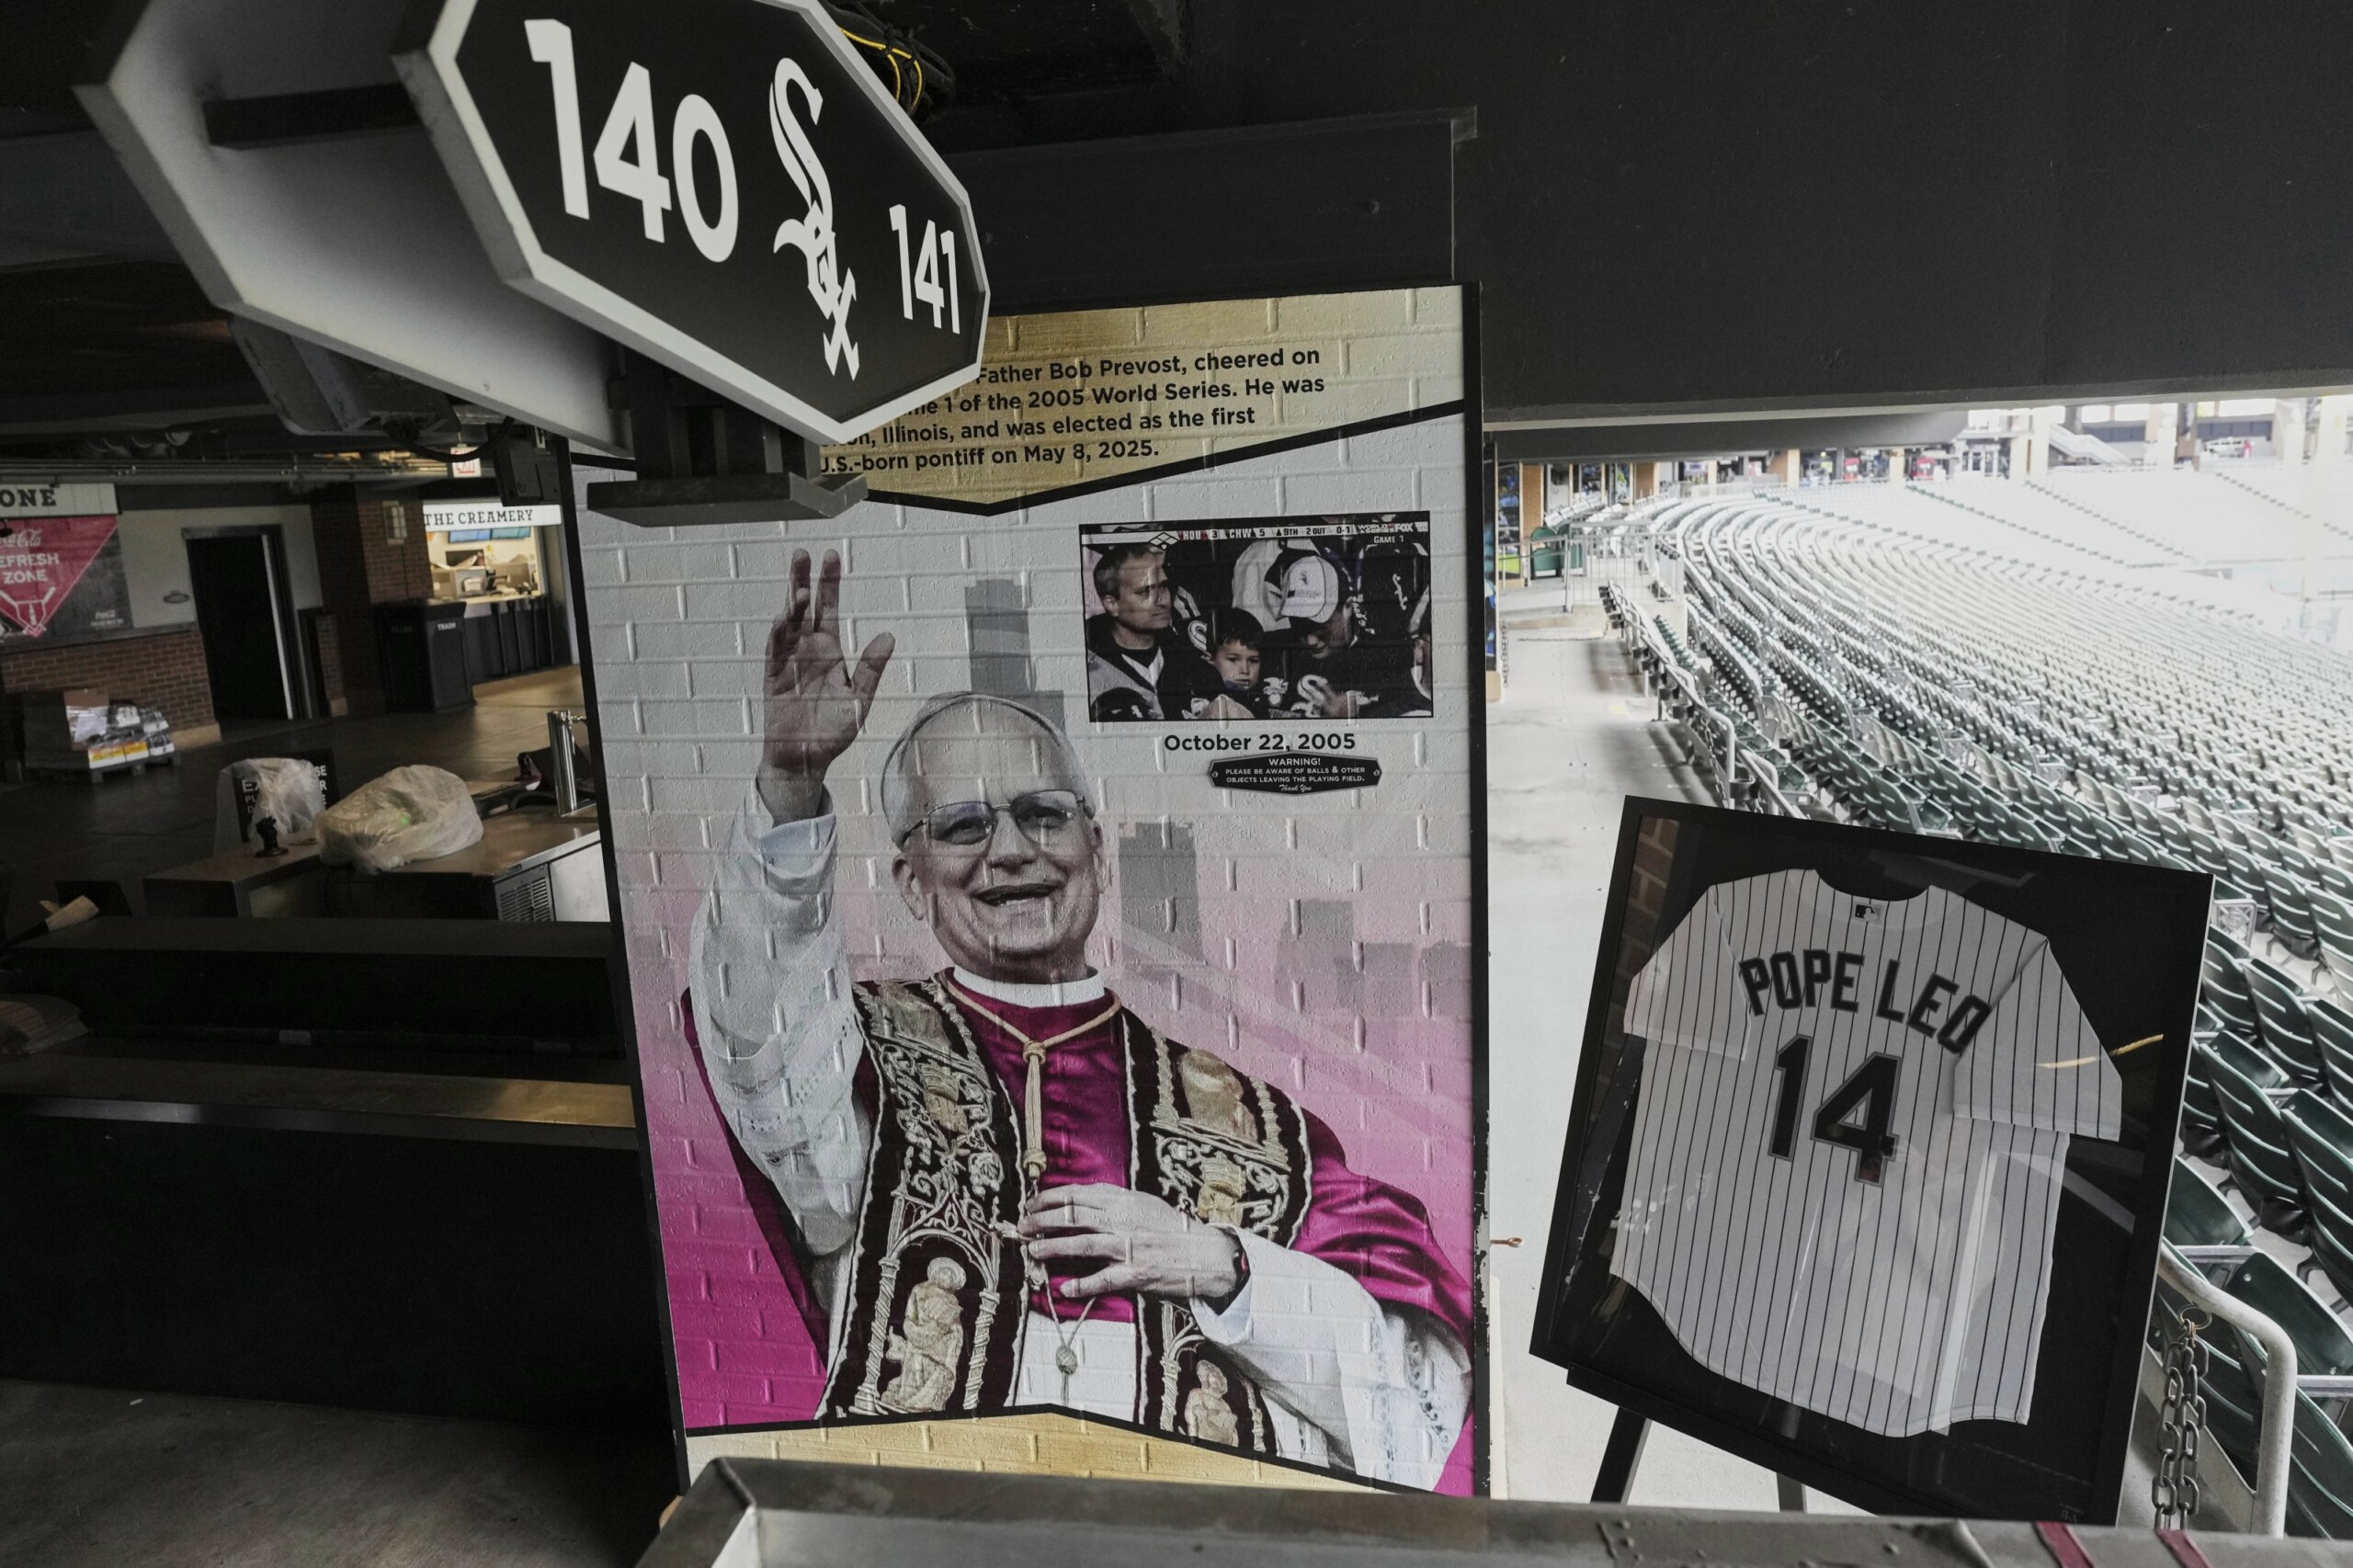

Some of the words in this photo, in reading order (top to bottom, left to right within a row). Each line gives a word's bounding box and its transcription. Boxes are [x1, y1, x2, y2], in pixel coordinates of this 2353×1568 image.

[525, 18, 738, 263] 140
[889, 204, 961, 335] 141
[976, 365, 1042, 384] Father
[1050, 360, 1092, 380] Bob
[1100, 356, 1187, 376] Prevost,
[1194, 348, 1284, 370] cheered
[1291, 350, 1320, 365] on
[945, 397, 953, 413] 1
[960, 394, 982, 412] of
[988, 393, 1021, 410] the
[1029, 389, 1085, 408] 2005
[1092, 384, 1157, 404] World
[1165, 381, 1237, 401] Series.
[1245, 379, 1275, 395] He
[1282, 378, 1324, 393] was
[883, 423, 954, 444] Illinois,
[961, 420, 999, 438] and
[1006, 421, 1046, 437] was
[1052, 413, 1131, 434] elected
[1140, 415, 1163, 429] as
[1169, 409, 1204, 427] the
[1211, 406, 1255, 426] first
[915, 448, 985, 472] pontiff
[992, 449, 1017, 463] on
[1024, 445, 1065, 464] May
[1073, 443, 1091, 461] 8,
[1098, 439, 1159, 459] 2025.
[424, 513, 454, 526] THE
[458, 509, 533, 525] CREAMERY
[1183, 530, 1201, 540] HOU
[1211, 530, 1218, 539] 3
[1259, 528, 1266, 537] 5
[1305, 527, 1312, 535] 2
[1313, 527, 1325, 535] OUT
[1336, 526, 1350, 534] 0-1
[1394, 522, 1414, 533] FOX
[1374, 536, 1395, 544] GAME
[3, 570, 48, 584] ZONE
[1164, 734, 1252, 751] October
[1258, 733, 1290, 752] 22,
[1298, 733, 1356, 750] 2005
[1268, 757, 1321, 766] WARNING!
[1332, 766, 1338, 774] &
[1279, 784, 1299, 792] Thank
[1300, 784, 1313, 793] You
[1738, 949, 1865, 1017] POPE
[1876, 959, 1993, 1055] LEO
[1767, 1034, 1903, 1187] 14
